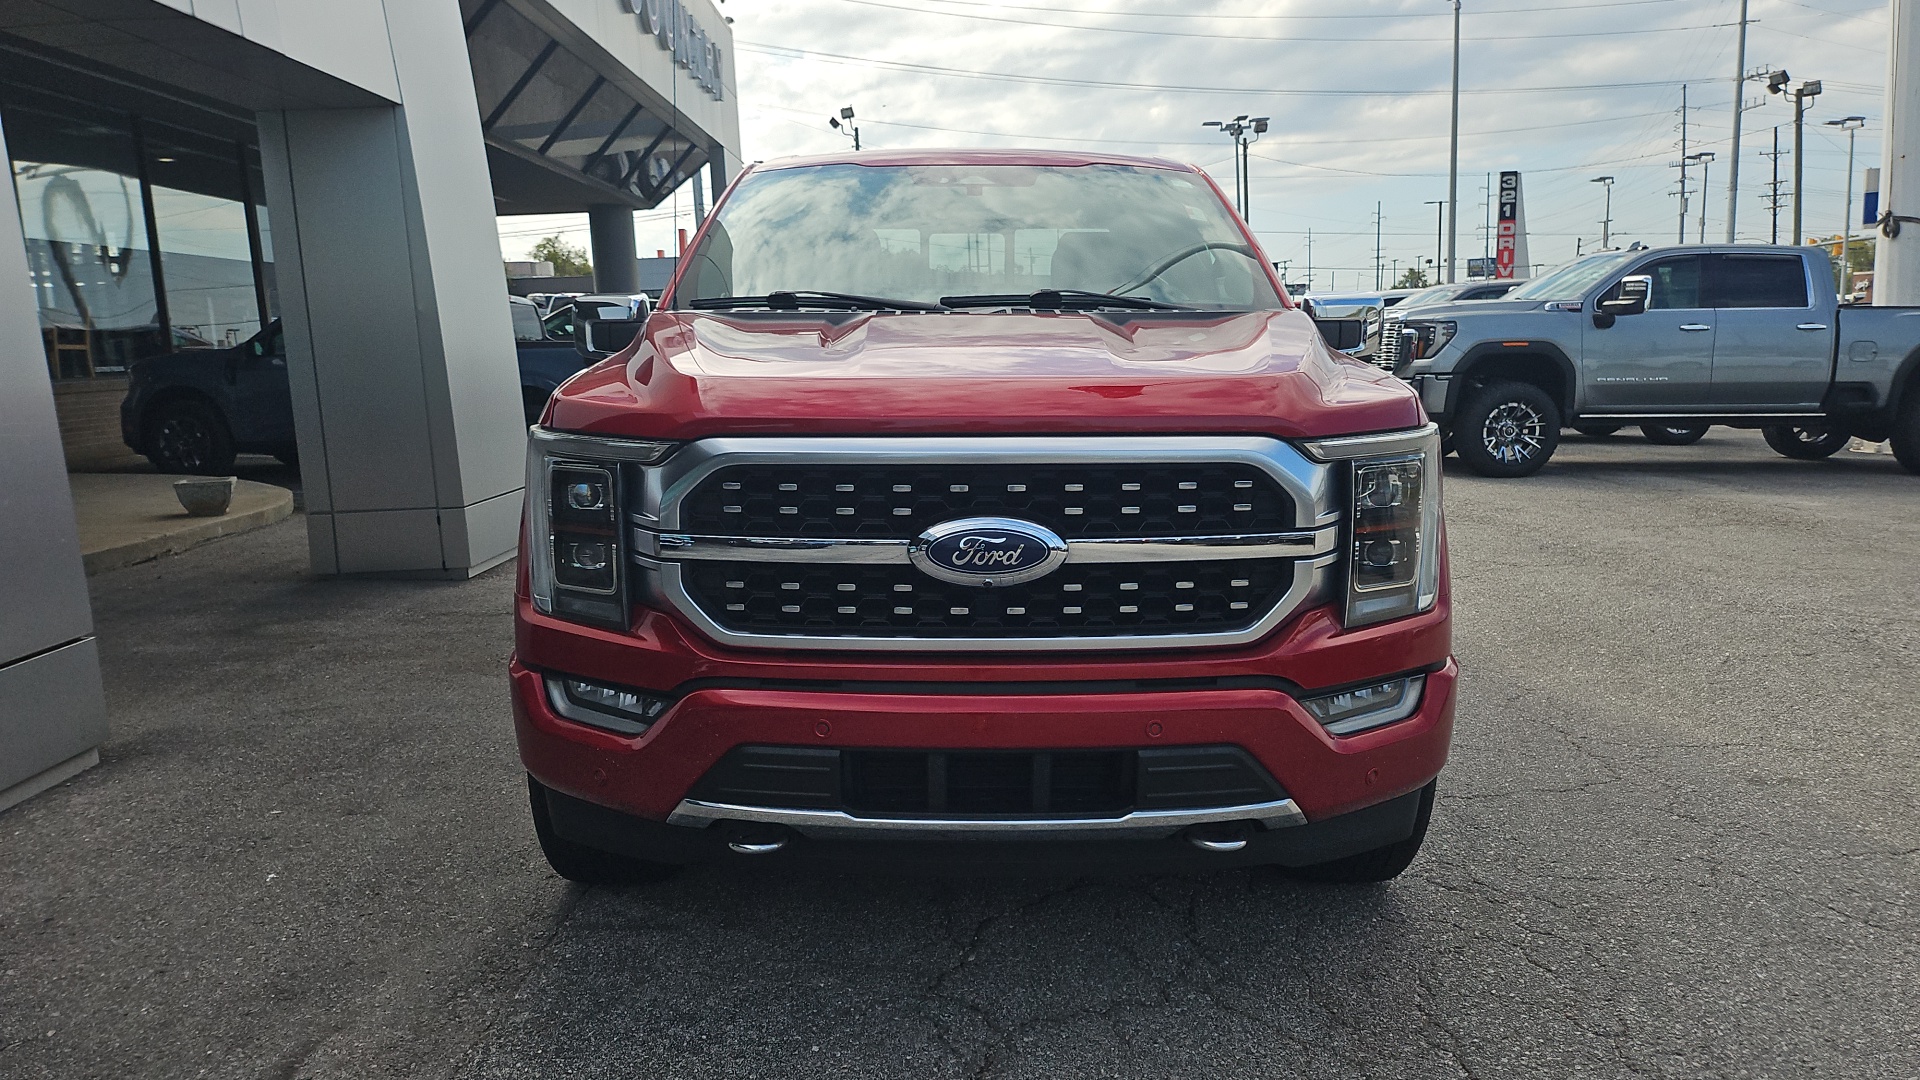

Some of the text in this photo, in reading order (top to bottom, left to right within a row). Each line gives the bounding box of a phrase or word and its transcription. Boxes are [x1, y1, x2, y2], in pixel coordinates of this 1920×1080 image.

[621, 0, 723, 101] UNTRY
[1501, 175, 1517, 217] 321
[951, 536, 1025, 566] Ford
